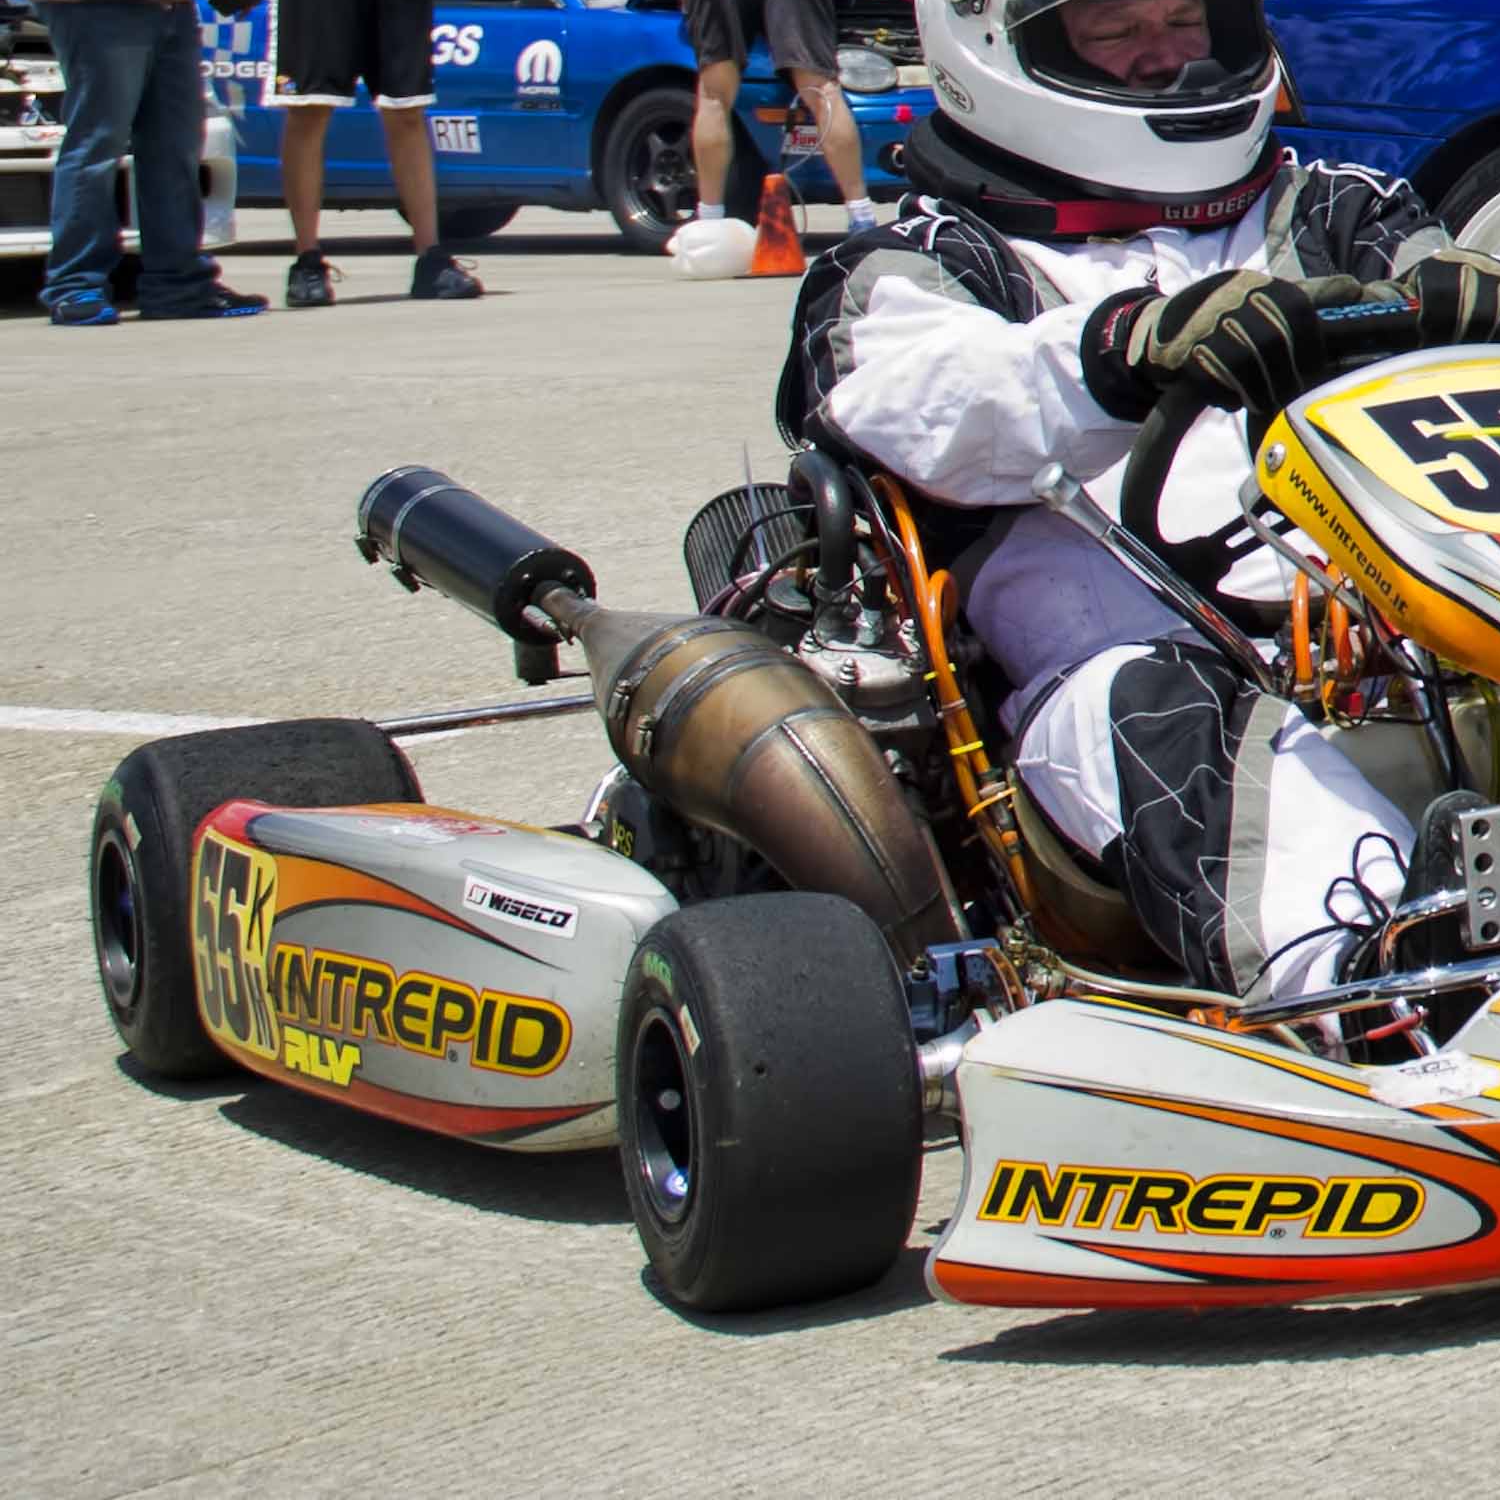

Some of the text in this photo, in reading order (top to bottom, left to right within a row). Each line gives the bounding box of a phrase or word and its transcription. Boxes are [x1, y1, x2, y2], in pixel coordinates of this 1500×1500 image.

[434, 117, 477, 152] RTF
[1288, 467, 1410, 618] www.intrepid.it
[488, 891, 574, 929] WISECO
[270, 948, 566, 1070] INTREPID
[283, 1024, 362, 1088] RLV
[983, 1164, 1420, 1238] INTREPID
